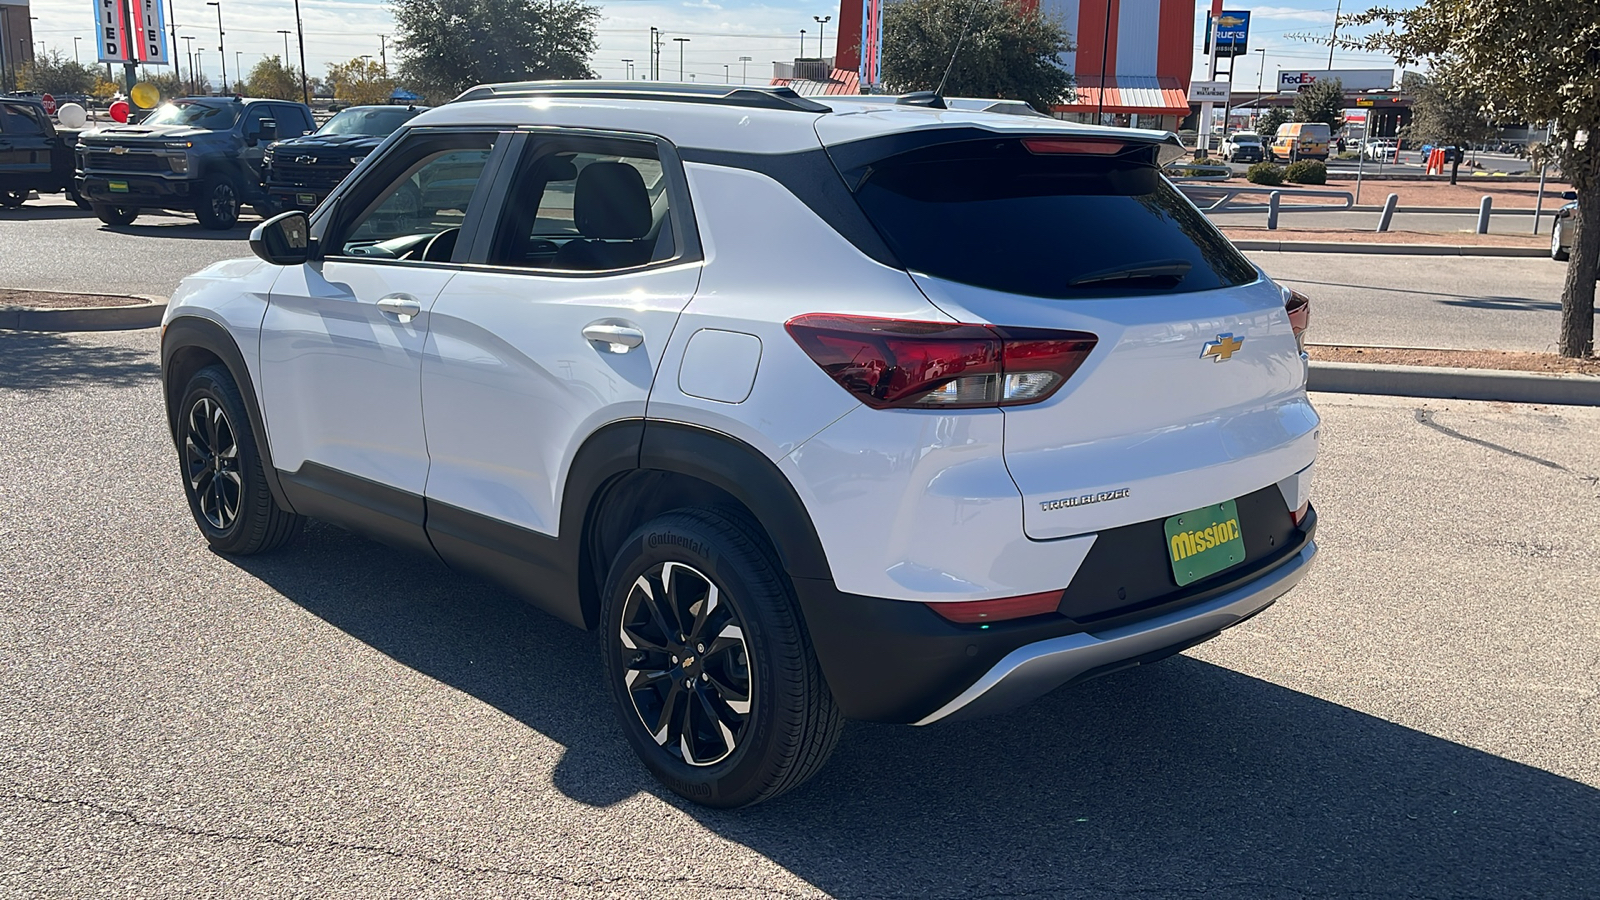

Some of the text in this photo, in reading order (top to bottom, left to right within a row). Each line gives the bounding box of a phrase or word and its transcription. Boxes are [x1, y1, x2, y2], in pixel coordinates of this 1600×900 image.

[1209, 31, 1245, 39] RUCKS
[1281, 73, 1316, 84] FedEx
[43, 100, 56, 109] STOP
[1039, 488, 1131, 511] TRAILBLAZER
[648, 531, 703, 555] Continental
